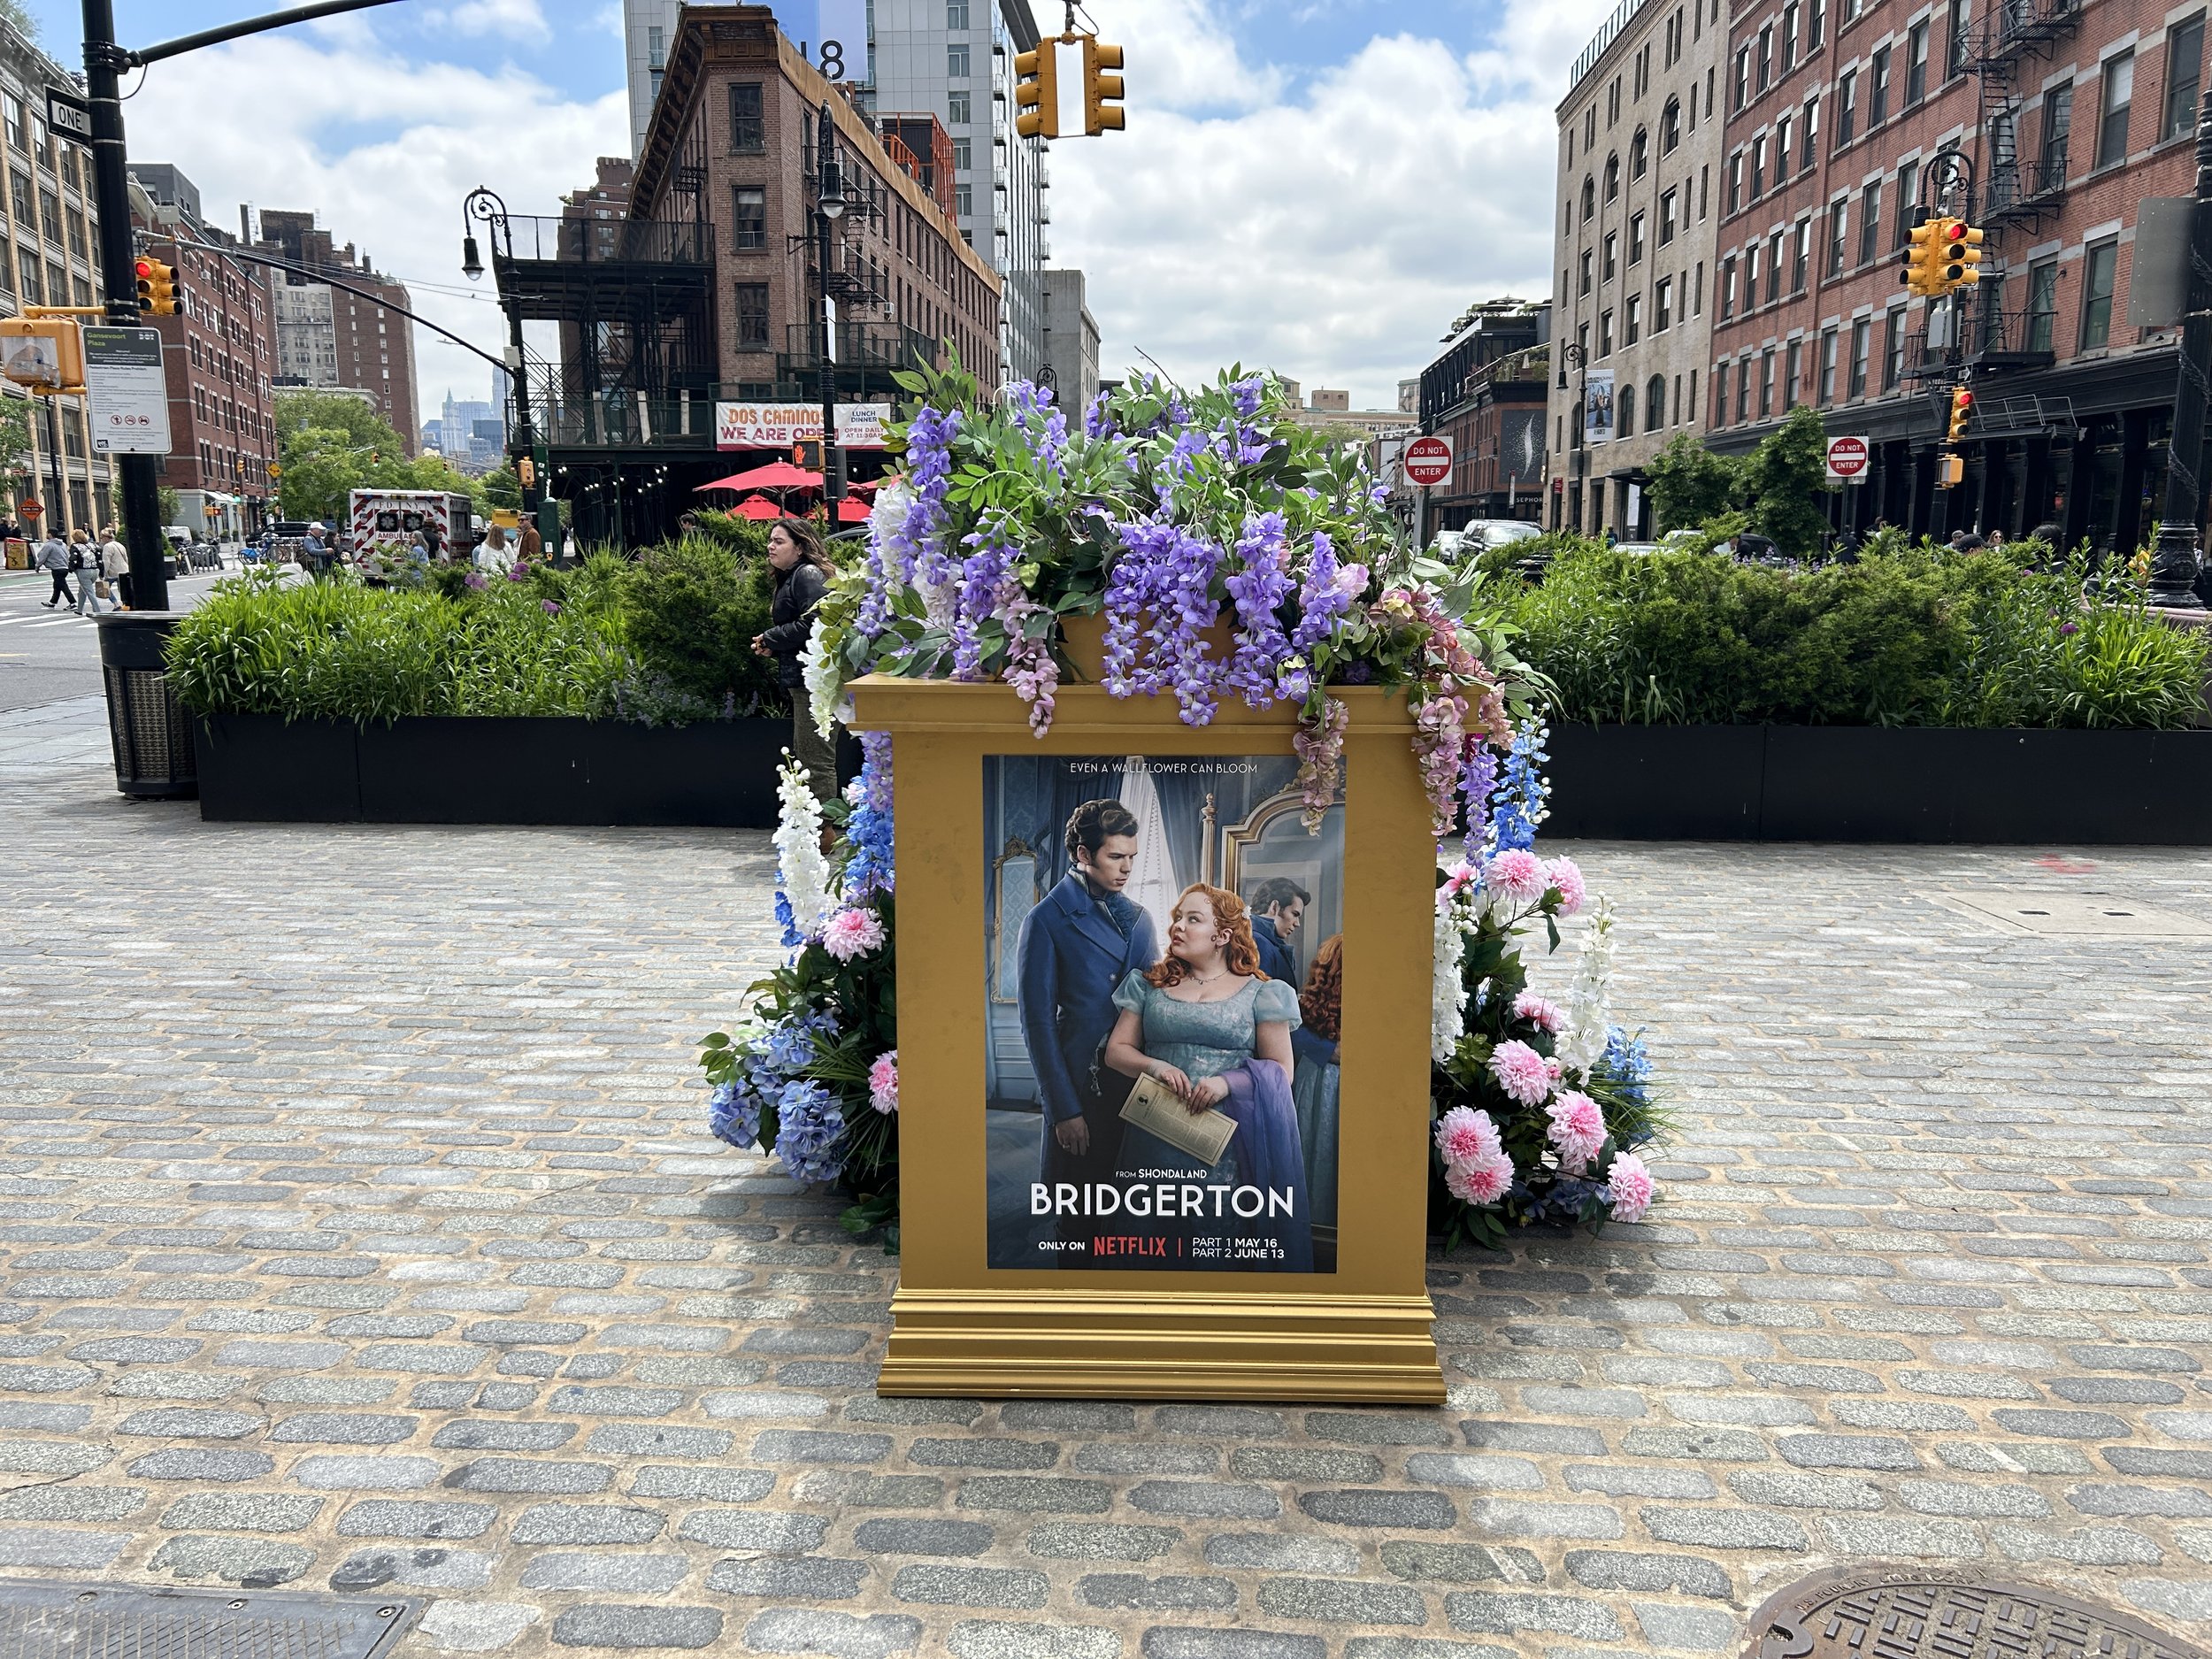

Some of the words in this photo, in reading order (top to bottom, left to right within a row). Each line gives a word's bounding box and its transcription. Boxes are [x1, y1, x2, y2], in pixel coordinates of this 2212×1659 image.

[58, 106, 82, 131] ONE
[728, 408, 758, 425] DOS
[720, 426, 747, 440] WE
[752, 428, 787, 441] ARE
[1427, 446, 1444, 455] NOT
[1415, 467, 1441, 476] ENTER
[1070, 763, 1097, 773] EVEN
[1101, 763, 1109, 773] A
[1111, 763, 1187, 773] WALLFLOWER
[1190, 763, 1213, 773] CAN
[1216, 764, 1257, 773] BLOOM
[1138, 1168, 1208, 1179] SHONDALAND
[1031, 1183, 1294, 1217] BRIDGERTON
[1038, 1240, 1066, 1250] ONLY
[1068, 1240, 1086, 1250] ON
[1094, 1236, 1166, 1257] NETFLIX
[1192, 1237, 1222, 1247] PART
[1225, 1238, 1231, 1247] 1
[1234, 1238, 1261, 1248] MAY
[1263, 1238, 1278, 1248] 16
[1192, 1248, 1223, 1257] PART
[1224, 1248, 1232, 1257] 2
[1234, 1248, 1268, 1258] JUNE
[1271, 1248, 1285, 1259] 13
